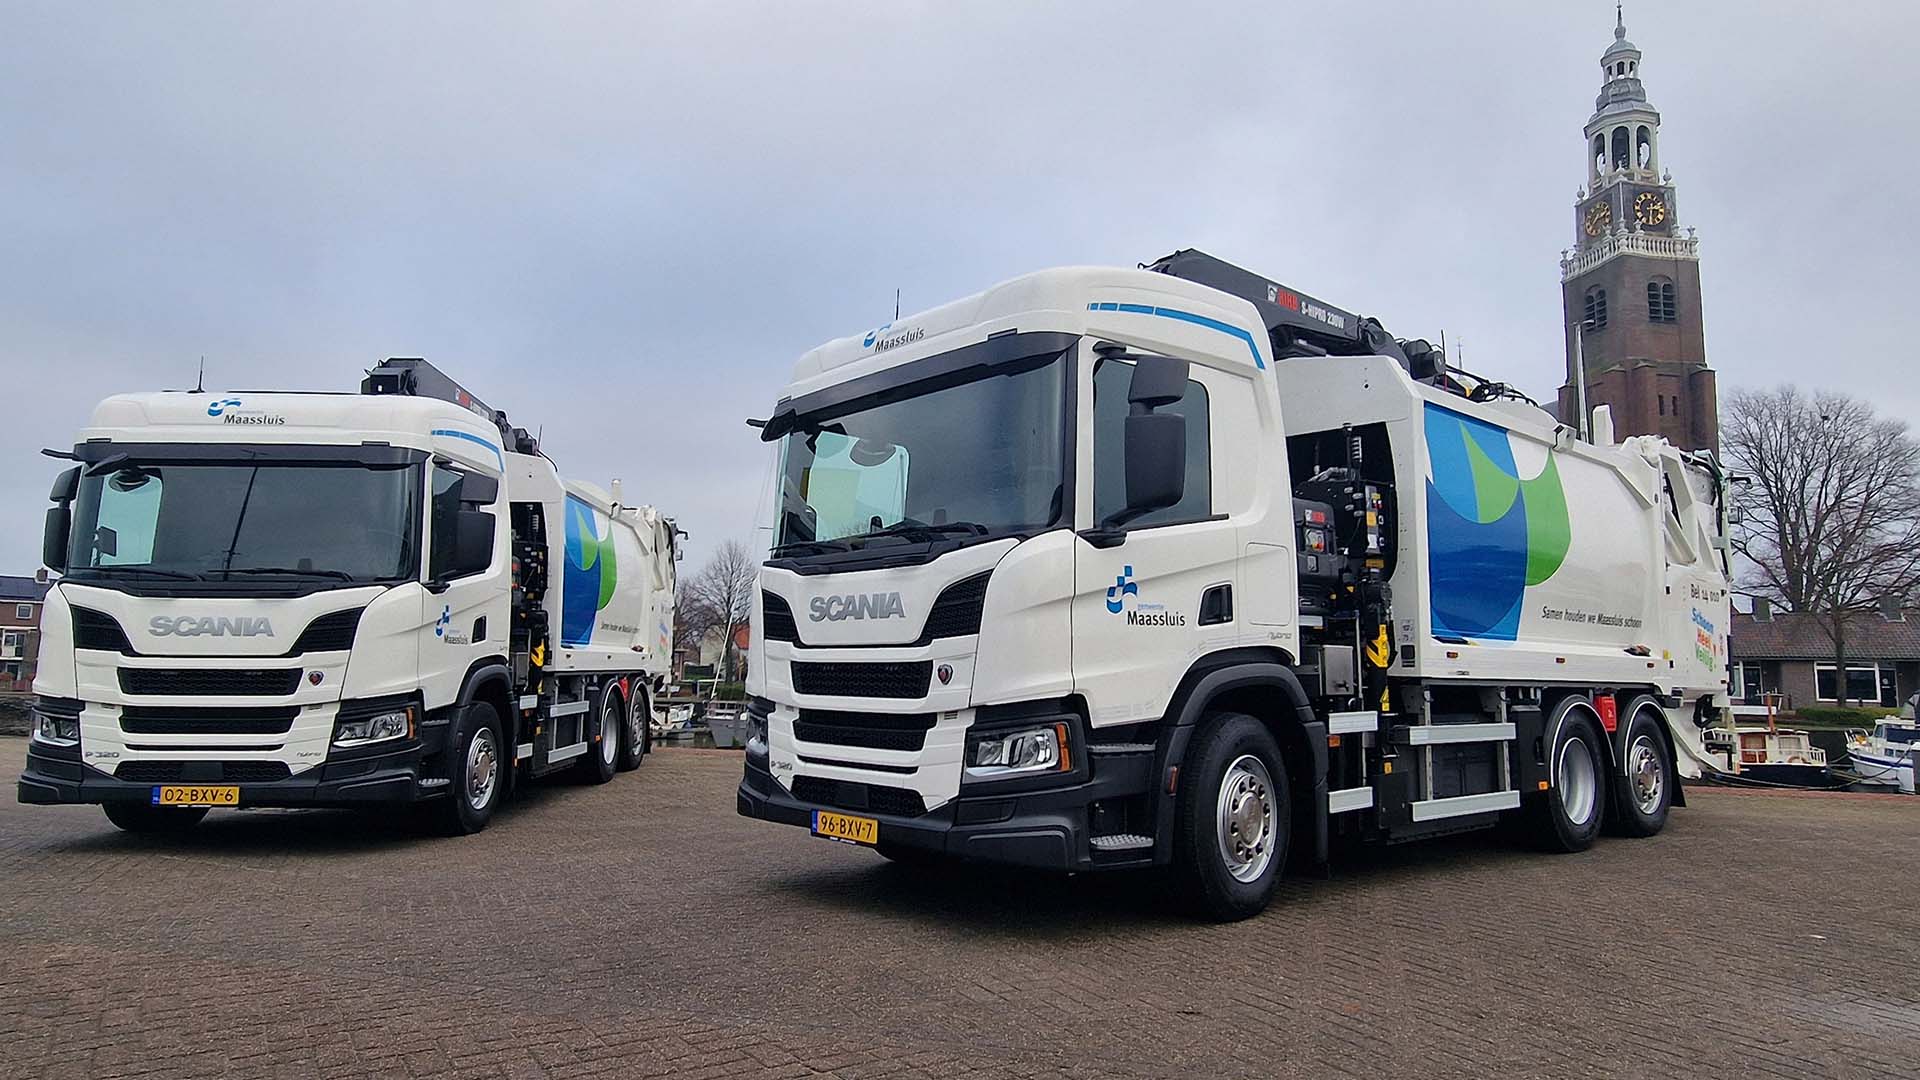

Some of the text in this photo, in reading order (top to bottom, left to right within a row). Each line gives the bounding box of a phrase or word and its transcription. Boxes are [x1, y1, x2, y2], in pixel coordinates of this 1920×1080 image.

[875, 328, 924, 352] Maassluis
[223, 414, 285, 425] Maassluis
[808, 591, 906, 622] SCANIA
[1542, 606, 1563, 620] Samen
[148, 615, 274, 637] SCANIA
[1127, 611, 1186, 627] Maassluis
[164, 788, 234, 802] 02-BXV-6
[821, 815, 873, 839] 96-BXV-7
